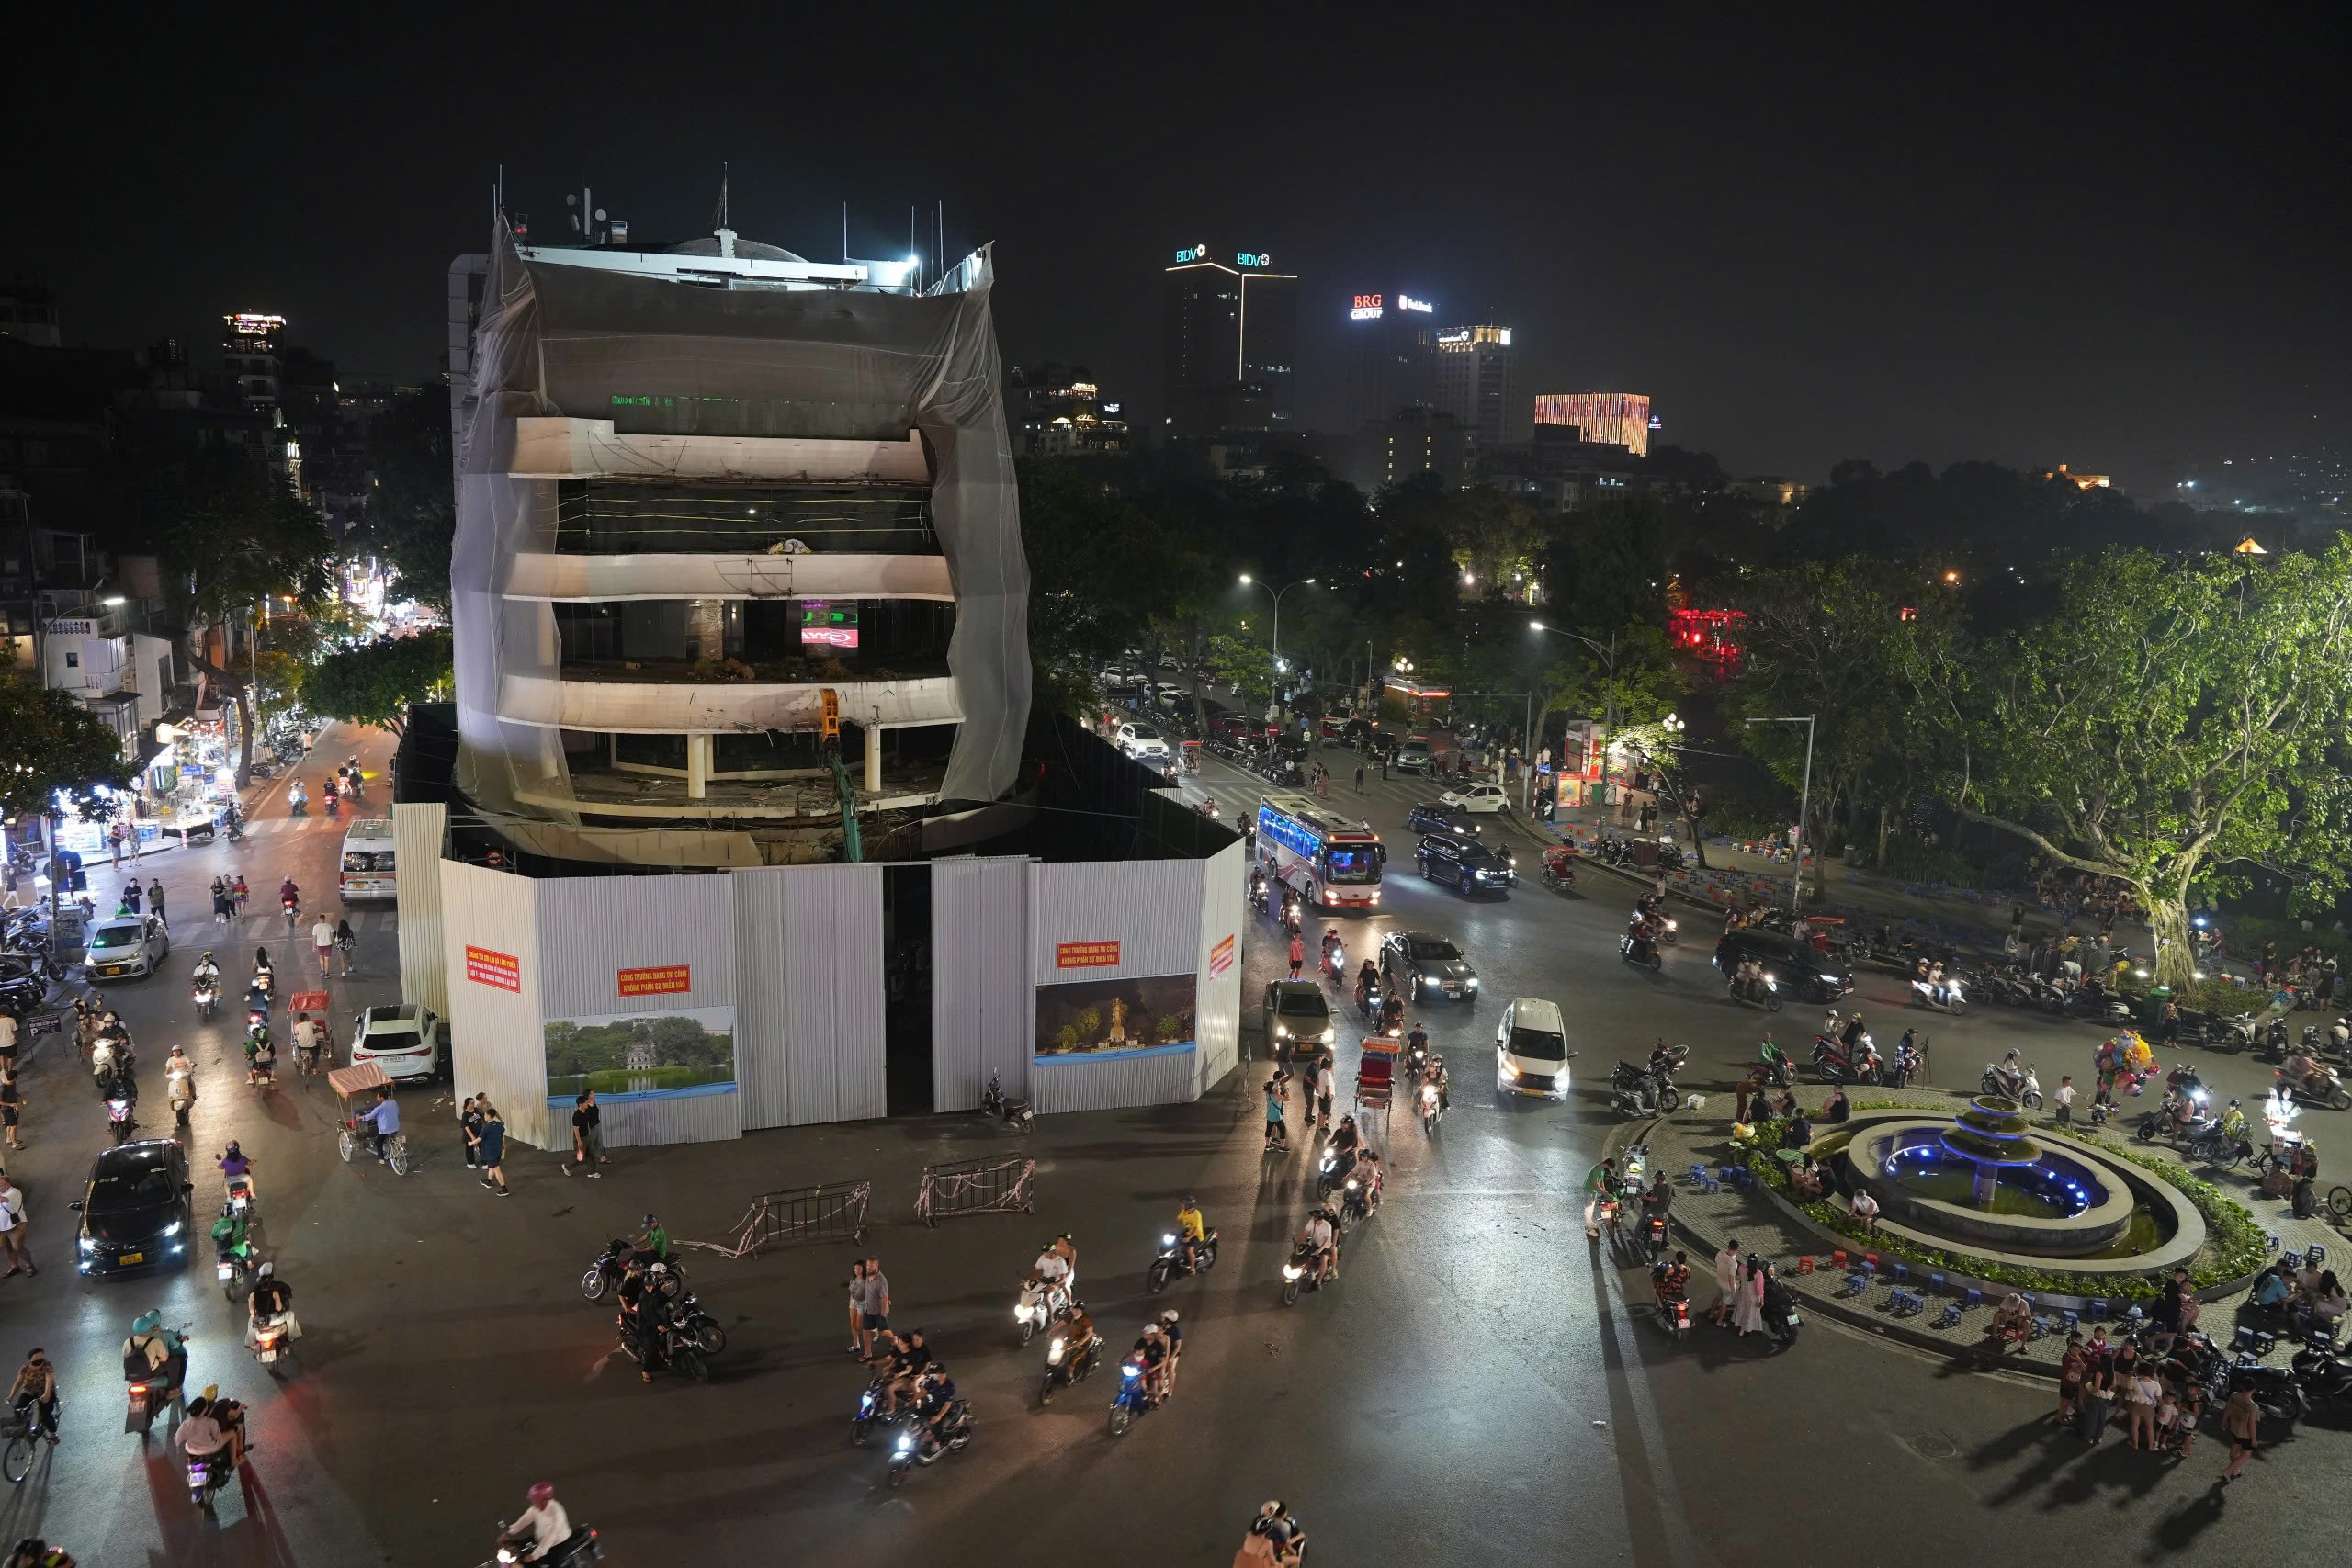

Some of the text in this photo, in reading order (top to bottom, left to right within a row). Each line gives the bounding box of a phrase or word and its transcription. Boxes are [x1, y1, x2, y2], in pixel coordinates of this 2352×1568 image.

[1176, 248, 1197, 263] BIDV
[1238, 253, 1261, 267] BIDV
[1354, 294, 1382, 309] BRG
[1351, 309, 1383, 320] GROUP
[31, 1028, 39, 1036] P
